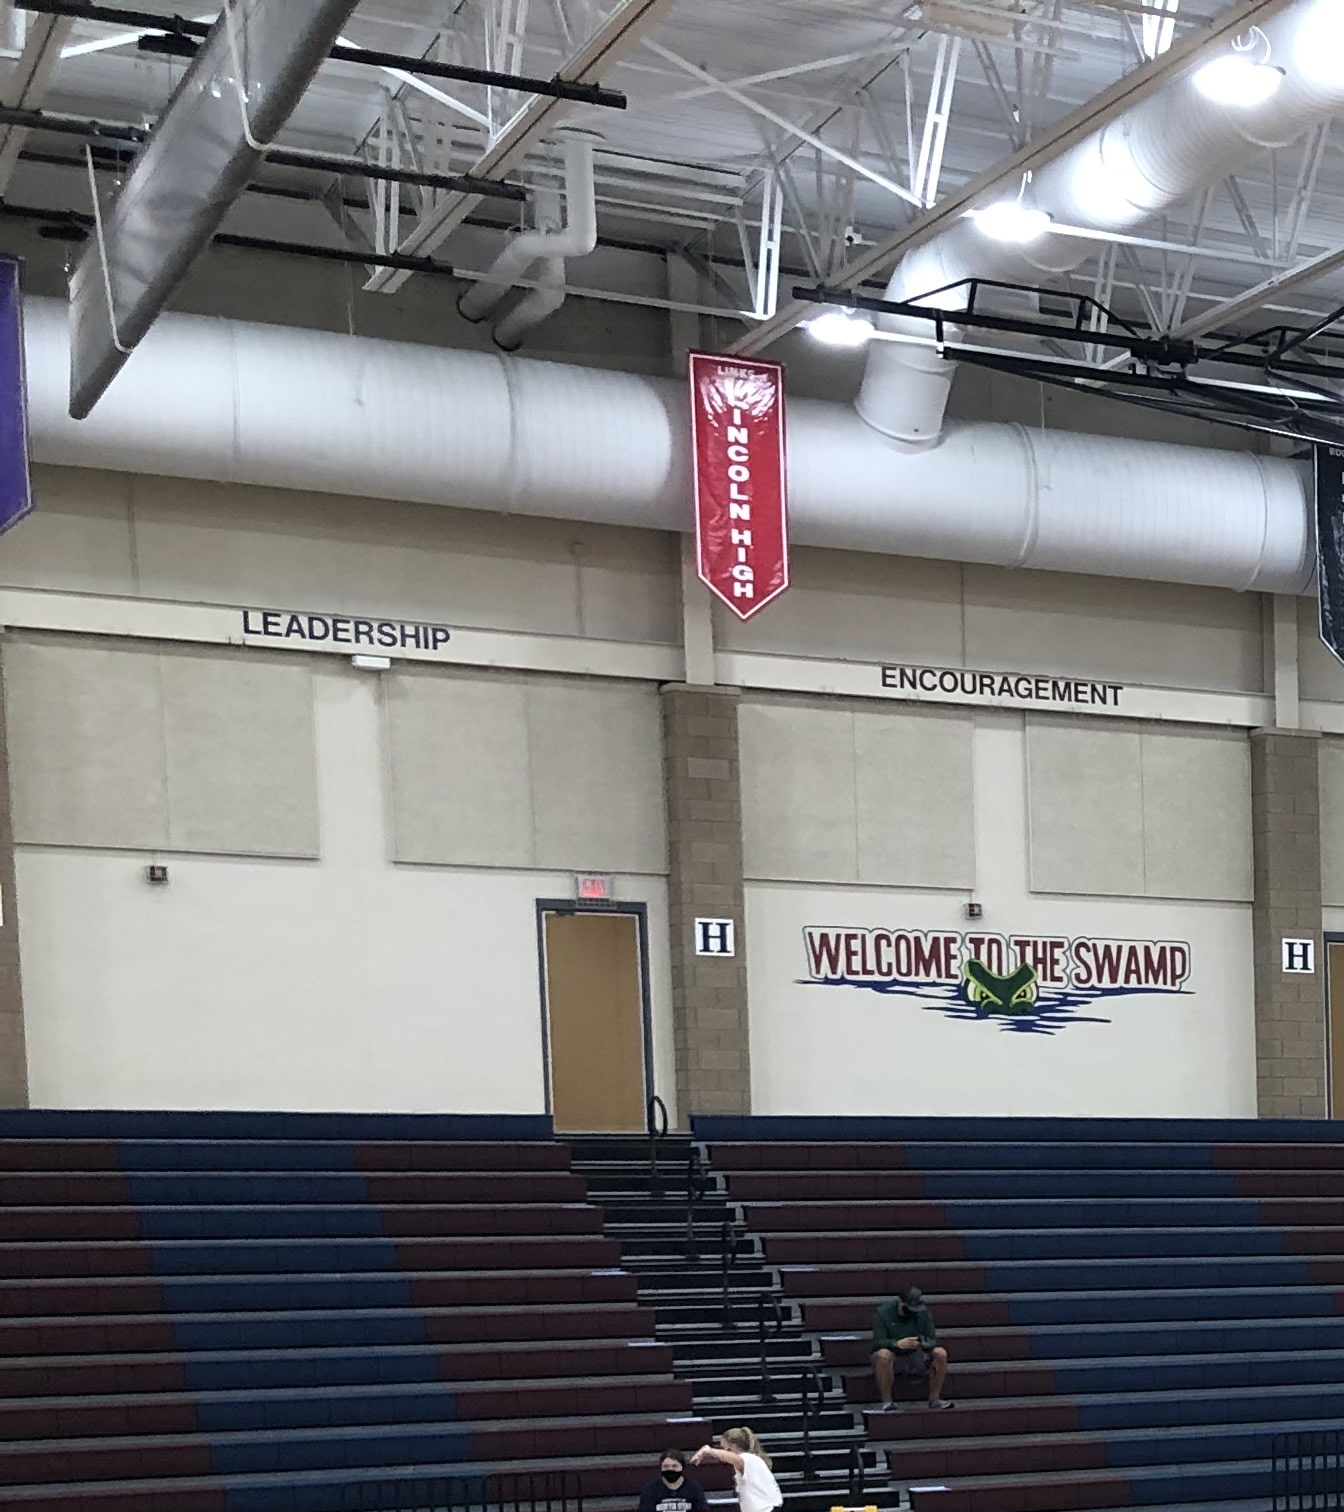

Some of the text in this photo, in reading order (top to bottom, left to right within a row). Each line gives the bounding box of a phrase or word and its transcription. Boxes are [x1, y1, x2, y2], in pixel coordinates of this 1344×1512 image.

[731, 529, 754, 598] HIGH
[243, 610, 450, 650] LEADERSHIP
[881, 666, 1123, 705] ENCOURAGEMENT
[698, 922, 731, 953] H
[1285, 942, 1312, 970] H
[808, 932, 1187, 986] WELCOME TO THE SWAMP
